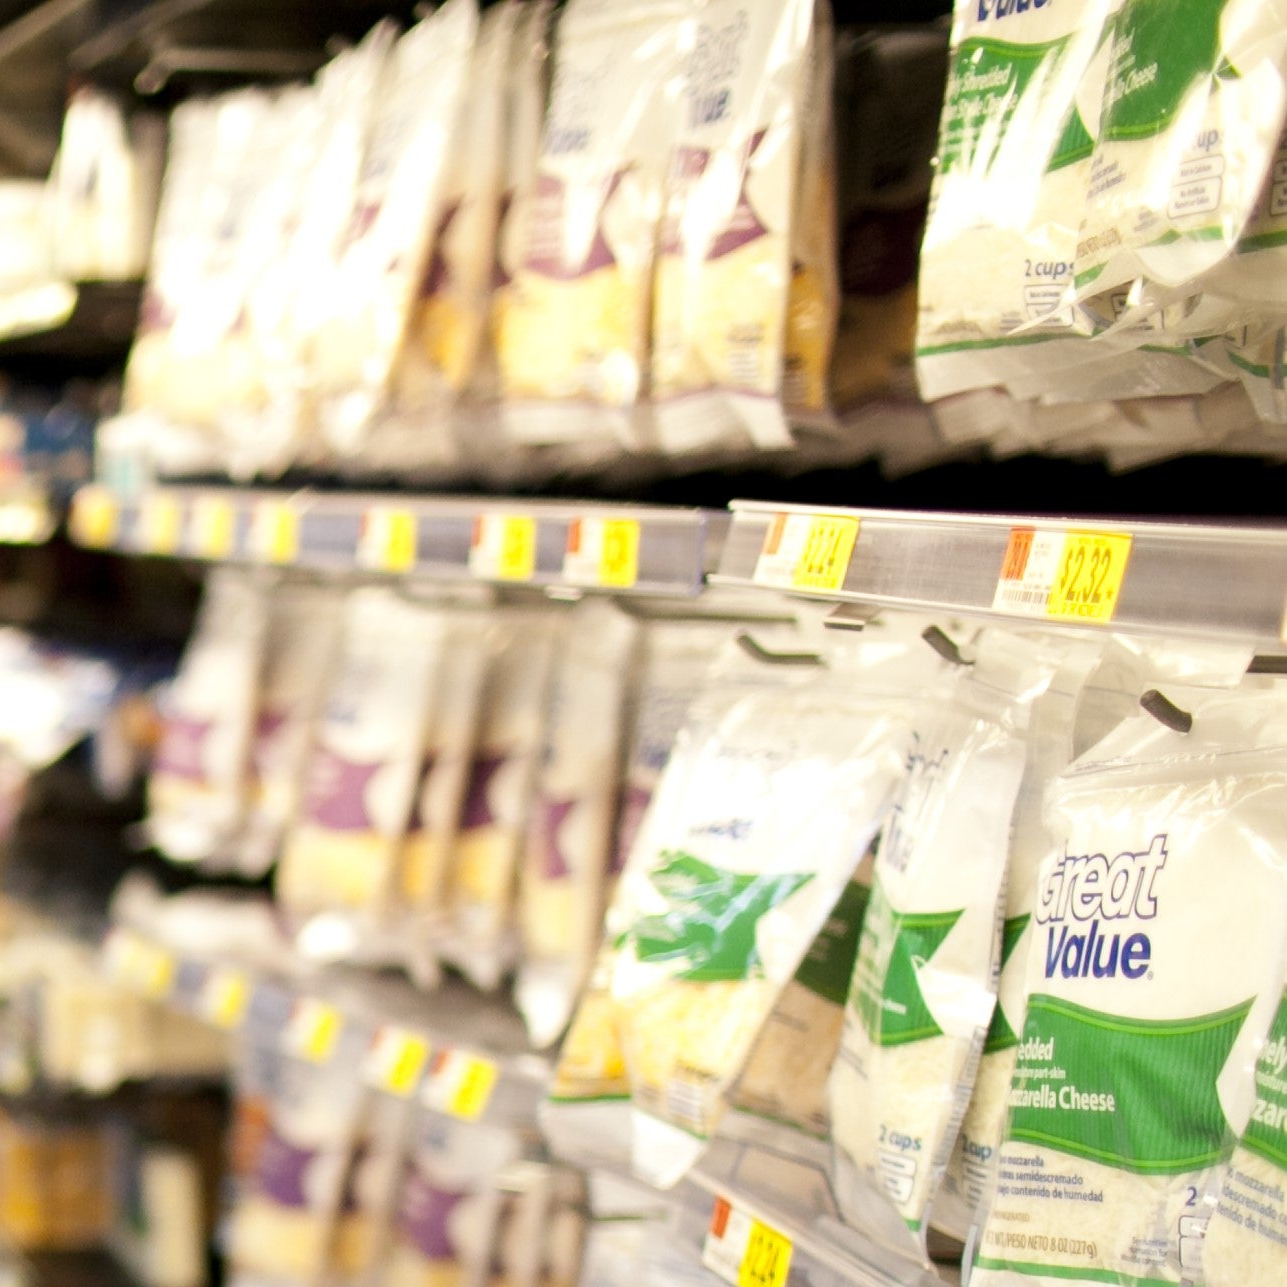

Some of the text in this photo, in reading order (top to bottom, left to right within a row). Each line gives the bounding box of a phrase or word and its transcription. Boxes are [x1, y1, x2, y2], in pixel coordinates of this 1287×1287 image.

[1060, 545, 1111, 603] $2.32
[1035, 834, 1168, 925] Great
[1045, 919, 1152, 979] Value
[1059, 1086, 1115, 1112] Cheese
[1185, 1186, 1197, 1206] 2
[1224, 1185, 1277, 1220] descremado
